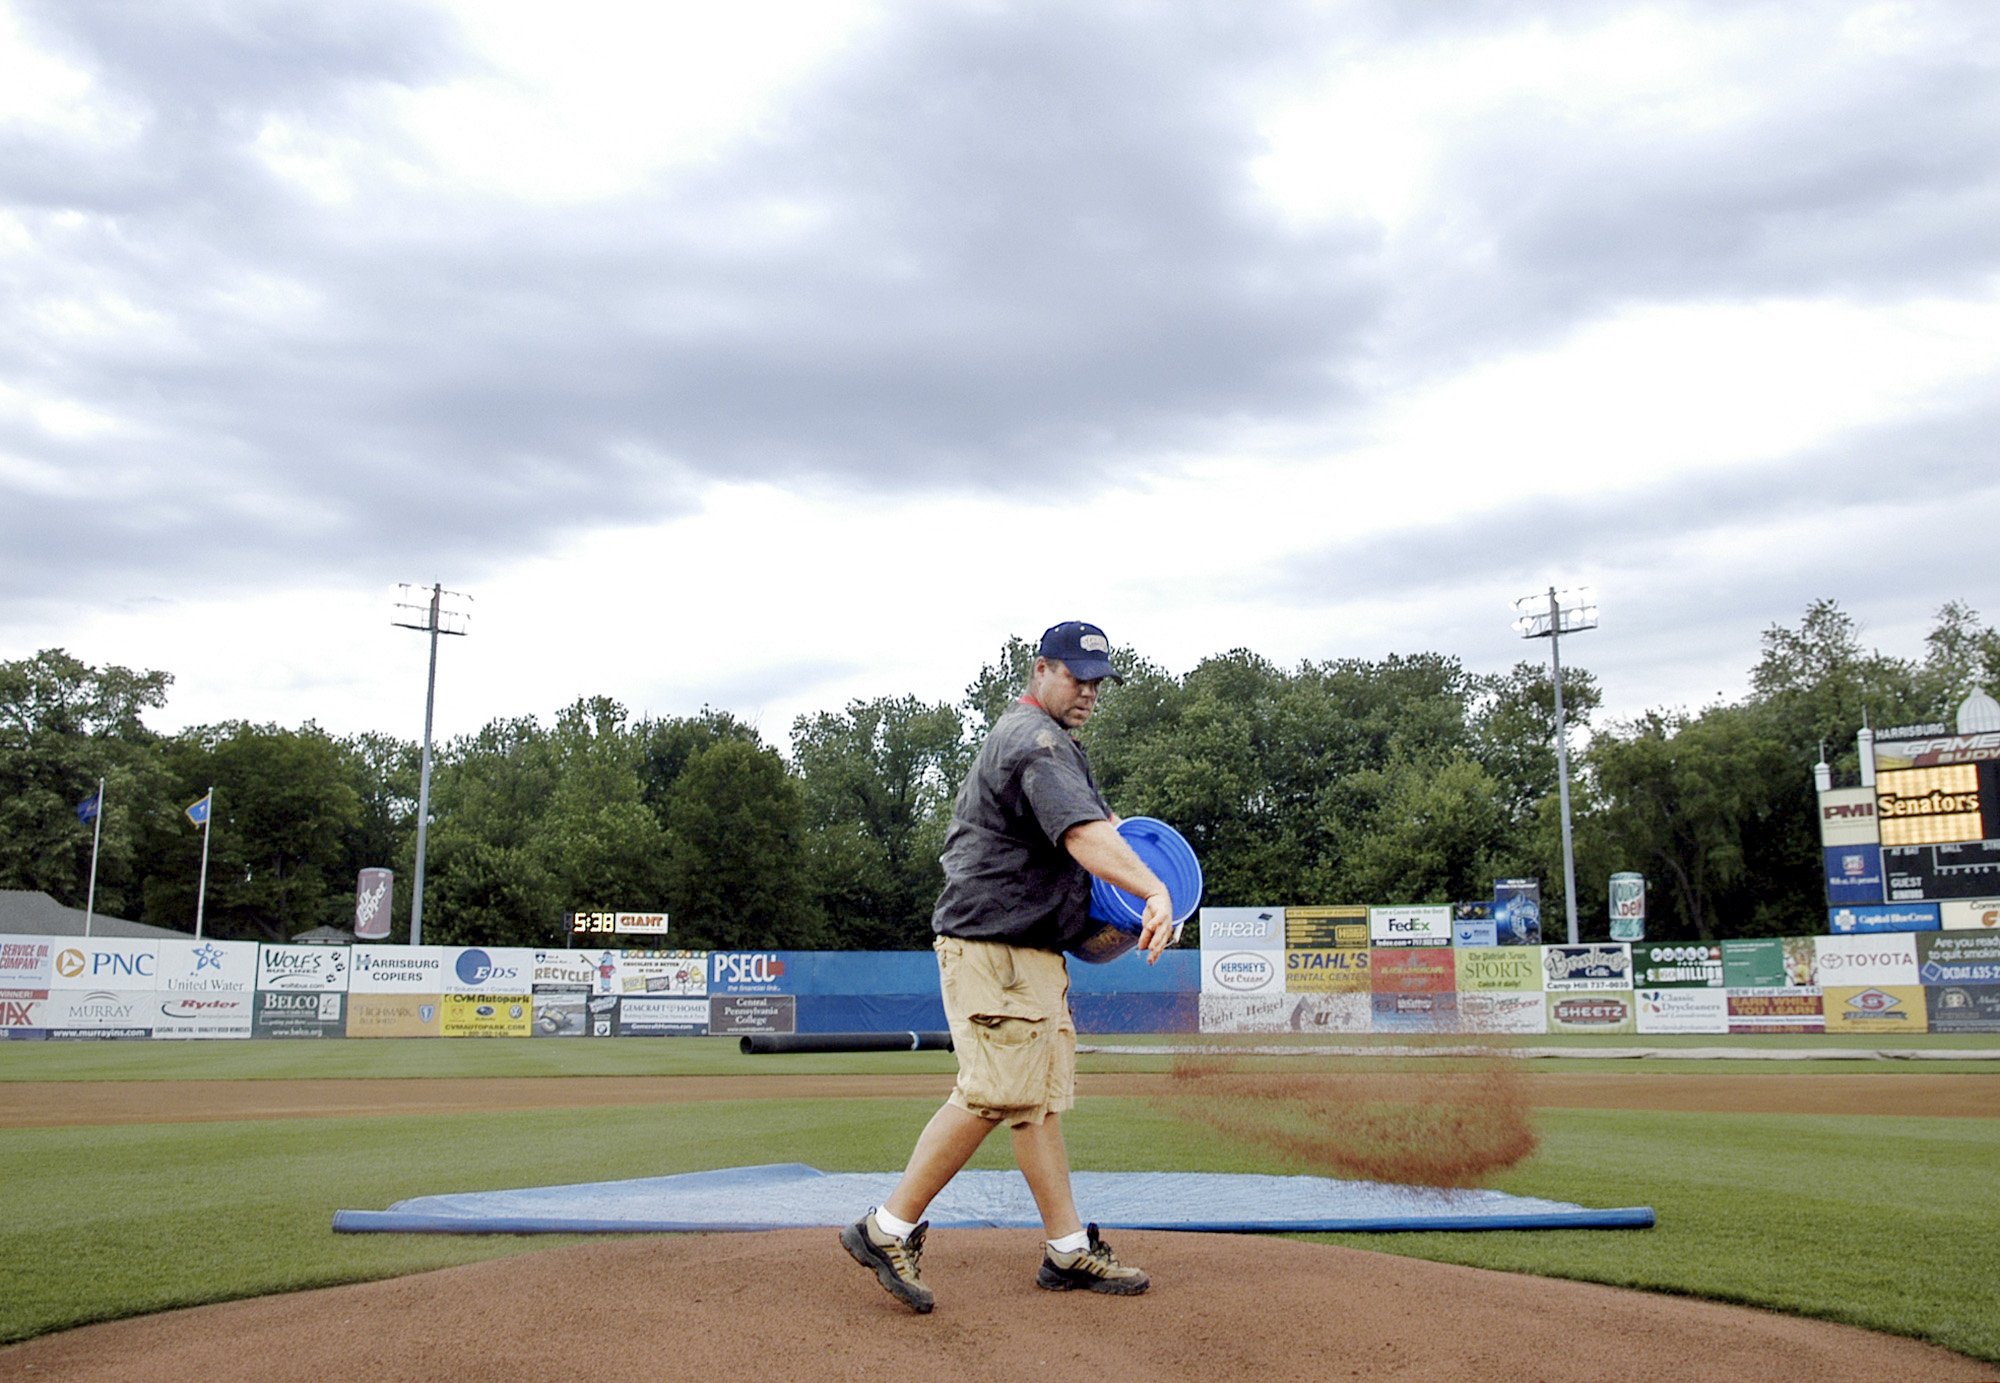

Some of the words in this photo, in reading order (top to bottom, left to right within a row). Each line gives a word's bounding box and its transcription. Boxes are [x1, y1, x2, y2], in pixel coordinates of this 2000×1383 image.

[1875, 723, 1945, 740] HARRISBURG
[1824, 803, 1873, 819] PMI
[1878, 794, 1980, 817] Senators
[1890, 877, 1922, 888] GUEST
[356, 881, 386, 928] Pepper
[573, 912, 614, 933] 5:38
[620, 916, 663, 926] GIANT
[1389, 918, 1430, 931] FedEx
[1858, 914, 1890, 926] Capital
[2, 943, 36, 957] SERVICE
[36, 944, 49, 957] OIL
[1934, 937, 1954, 949] Are
[1954, 938, 1975, 951] you
[265, 948, 322, 970] WOLF'S
[1287, 952, 1369, 970] STAHL'S
[1845, 953, 1914, 967] TOYOTA
[1928, 950, 1940, 960] to
[1941, 949, 1962, 962] quit
[0, 957, 41, 971] COMPANY
[91, 952, 155, 977] PNC
[355, 953, 440, 971] HARRISBURG
[713, 953, 777, 983] PSECU
[1220, 962, 1266, 974] HERSHEY'S
[473, 966, 519, 980] EDS
[535, 967, 595, 982] RECYCLE!
[1465, 961, 1533, 979] SPORTS
[372, 971, 424, 982] COPIERS
[1223, 974, 1235, 983] Ice
[1236, 975, 1264, 983] Cream
[1286, 973, 1326, 982] RENTAL
[167, 979, 208, 991] United
[210, 979, 245, 991] Water
[490, 986, 527, 994] Consulting
[739, 984, 765, 992] financial
[1546, 982, 1571, 992] Camp
[1660, 993, 1694, 1002] Classic
[1752, 989, 1775, 997] Local
[1777, 988, 1802, 996] Union
[180, 999, 240, 1010] Ryder
[264, 992, 318, 1010] BELCO
[477, 994, 530, 1004] Autopark
[736, 998, 767, 1007] Central
[68, 1005, 134, 1018] MURRAY
[622, 1004, 666, 1013] GEMCRAFT
[676, 1004, 707, 1012] HOMES
[724, 1006, 779, 1016] Pennsylvania
[1558, 1006, 1623, 1018] SHEETZ
[1736, 1006, 1765, 1015] YOU
[631, 1022, 694, 1030] GemcraftHomes.com
[735, 1015, 767, 1026] College
[272, 1026, 323, 1037] www.belco.org
[445, 1023, 526, 1031] CVMAUTOPARK.COM
[53, 1029, 146, 1038] www.murrayins.com
